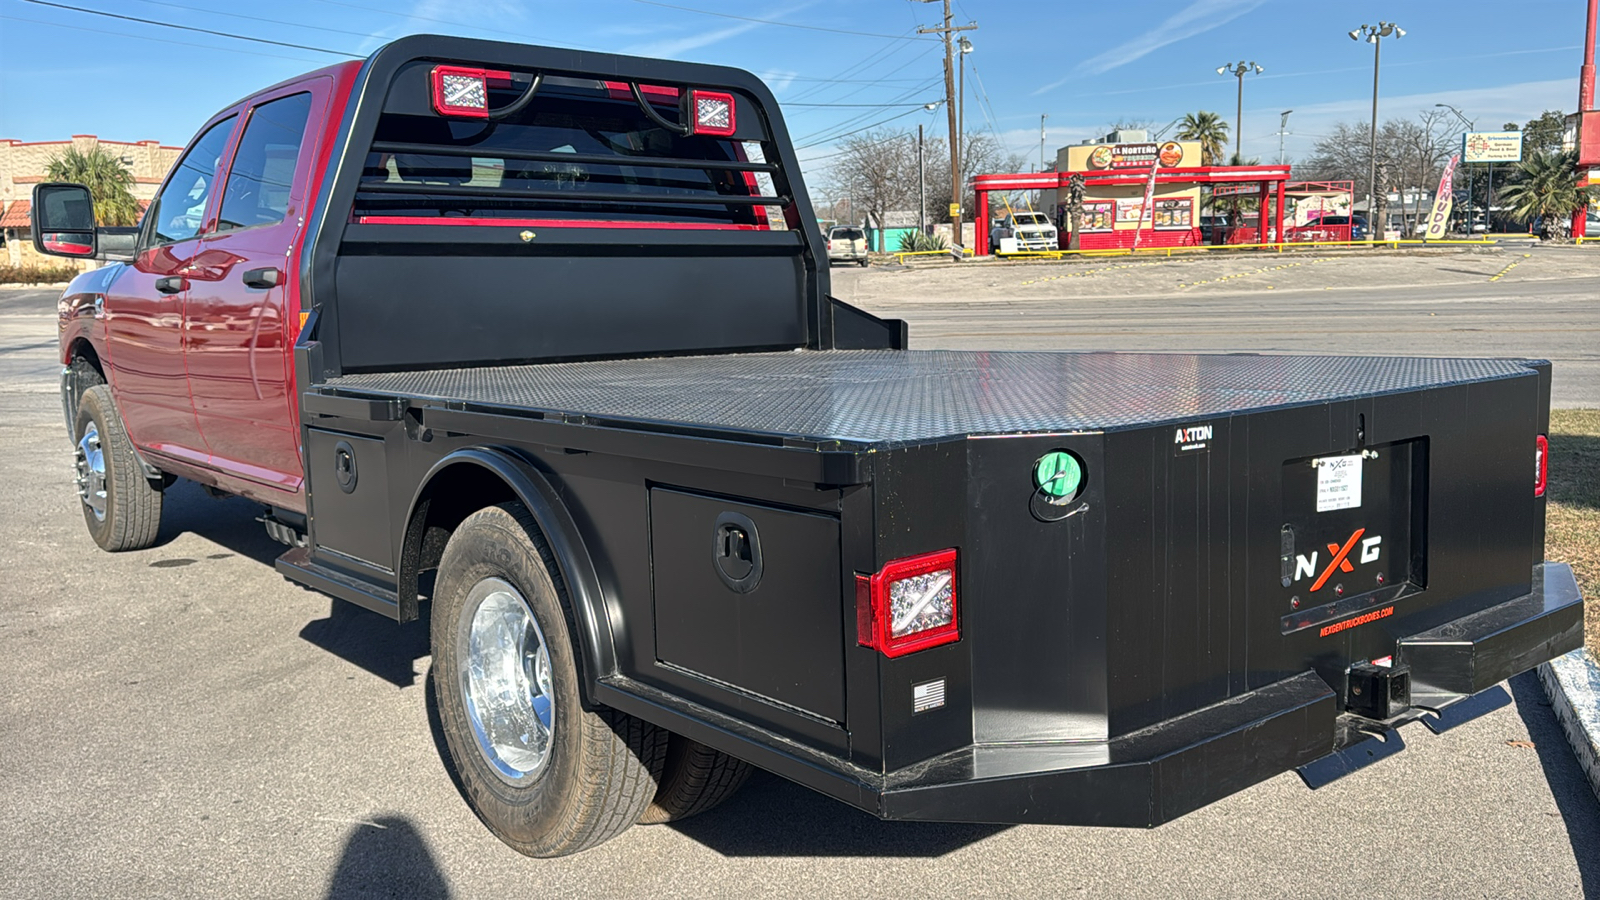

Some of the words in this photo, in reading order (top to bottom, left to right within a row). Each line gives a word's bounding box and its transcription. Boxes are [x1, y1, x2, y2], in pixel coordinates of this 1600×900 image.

[1112, 147, 1121, 155] EL
[1122, 145, 1157, 155] NORTEÑO
[1430, 168, 1451, 234] MENUDO
[1174, 425, 1213, 444] AXTON
[1294, 527, 1382, 592] NXG
[1319, 606, 1394, 638] NEXGENTRUCKBODIES.COM
